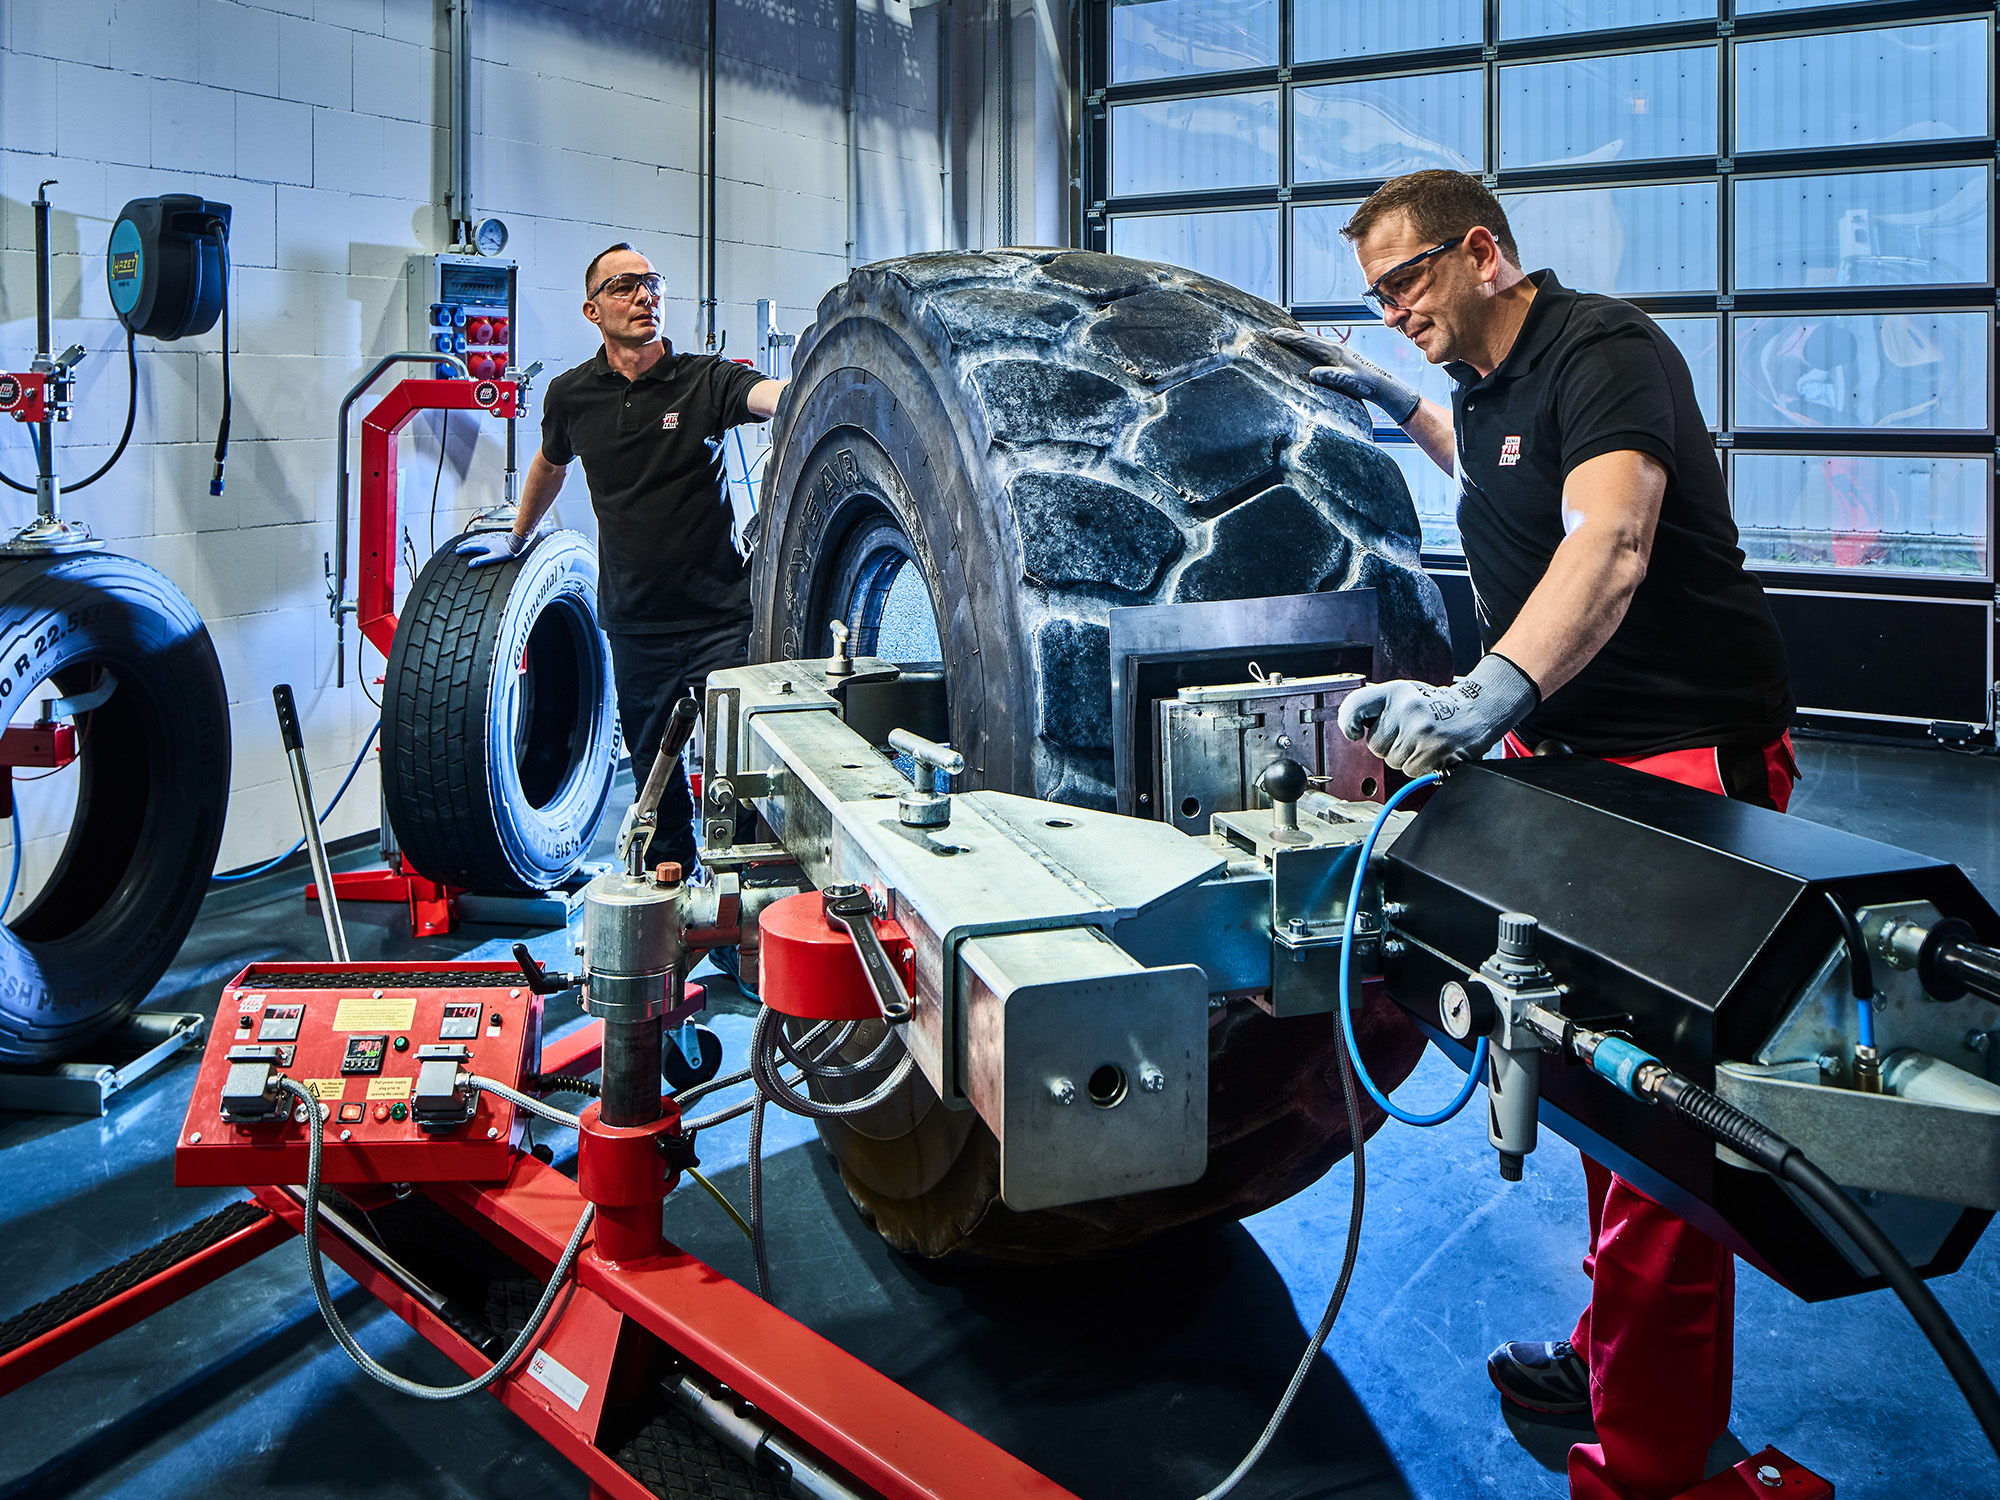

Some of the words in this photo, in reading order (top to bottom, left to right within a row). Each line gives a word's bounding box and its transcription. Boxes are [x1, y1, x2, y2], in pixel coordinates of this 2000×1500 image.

[114, 259, 136, 273] HAZET
[514, 565, 558, 670] Continental
[14, 653, 31, 678] R
[34, 611, 79, 659] 22.5
[273, 1009, 300, 1019] 174
[452, 1007, 478, 1018] 140
